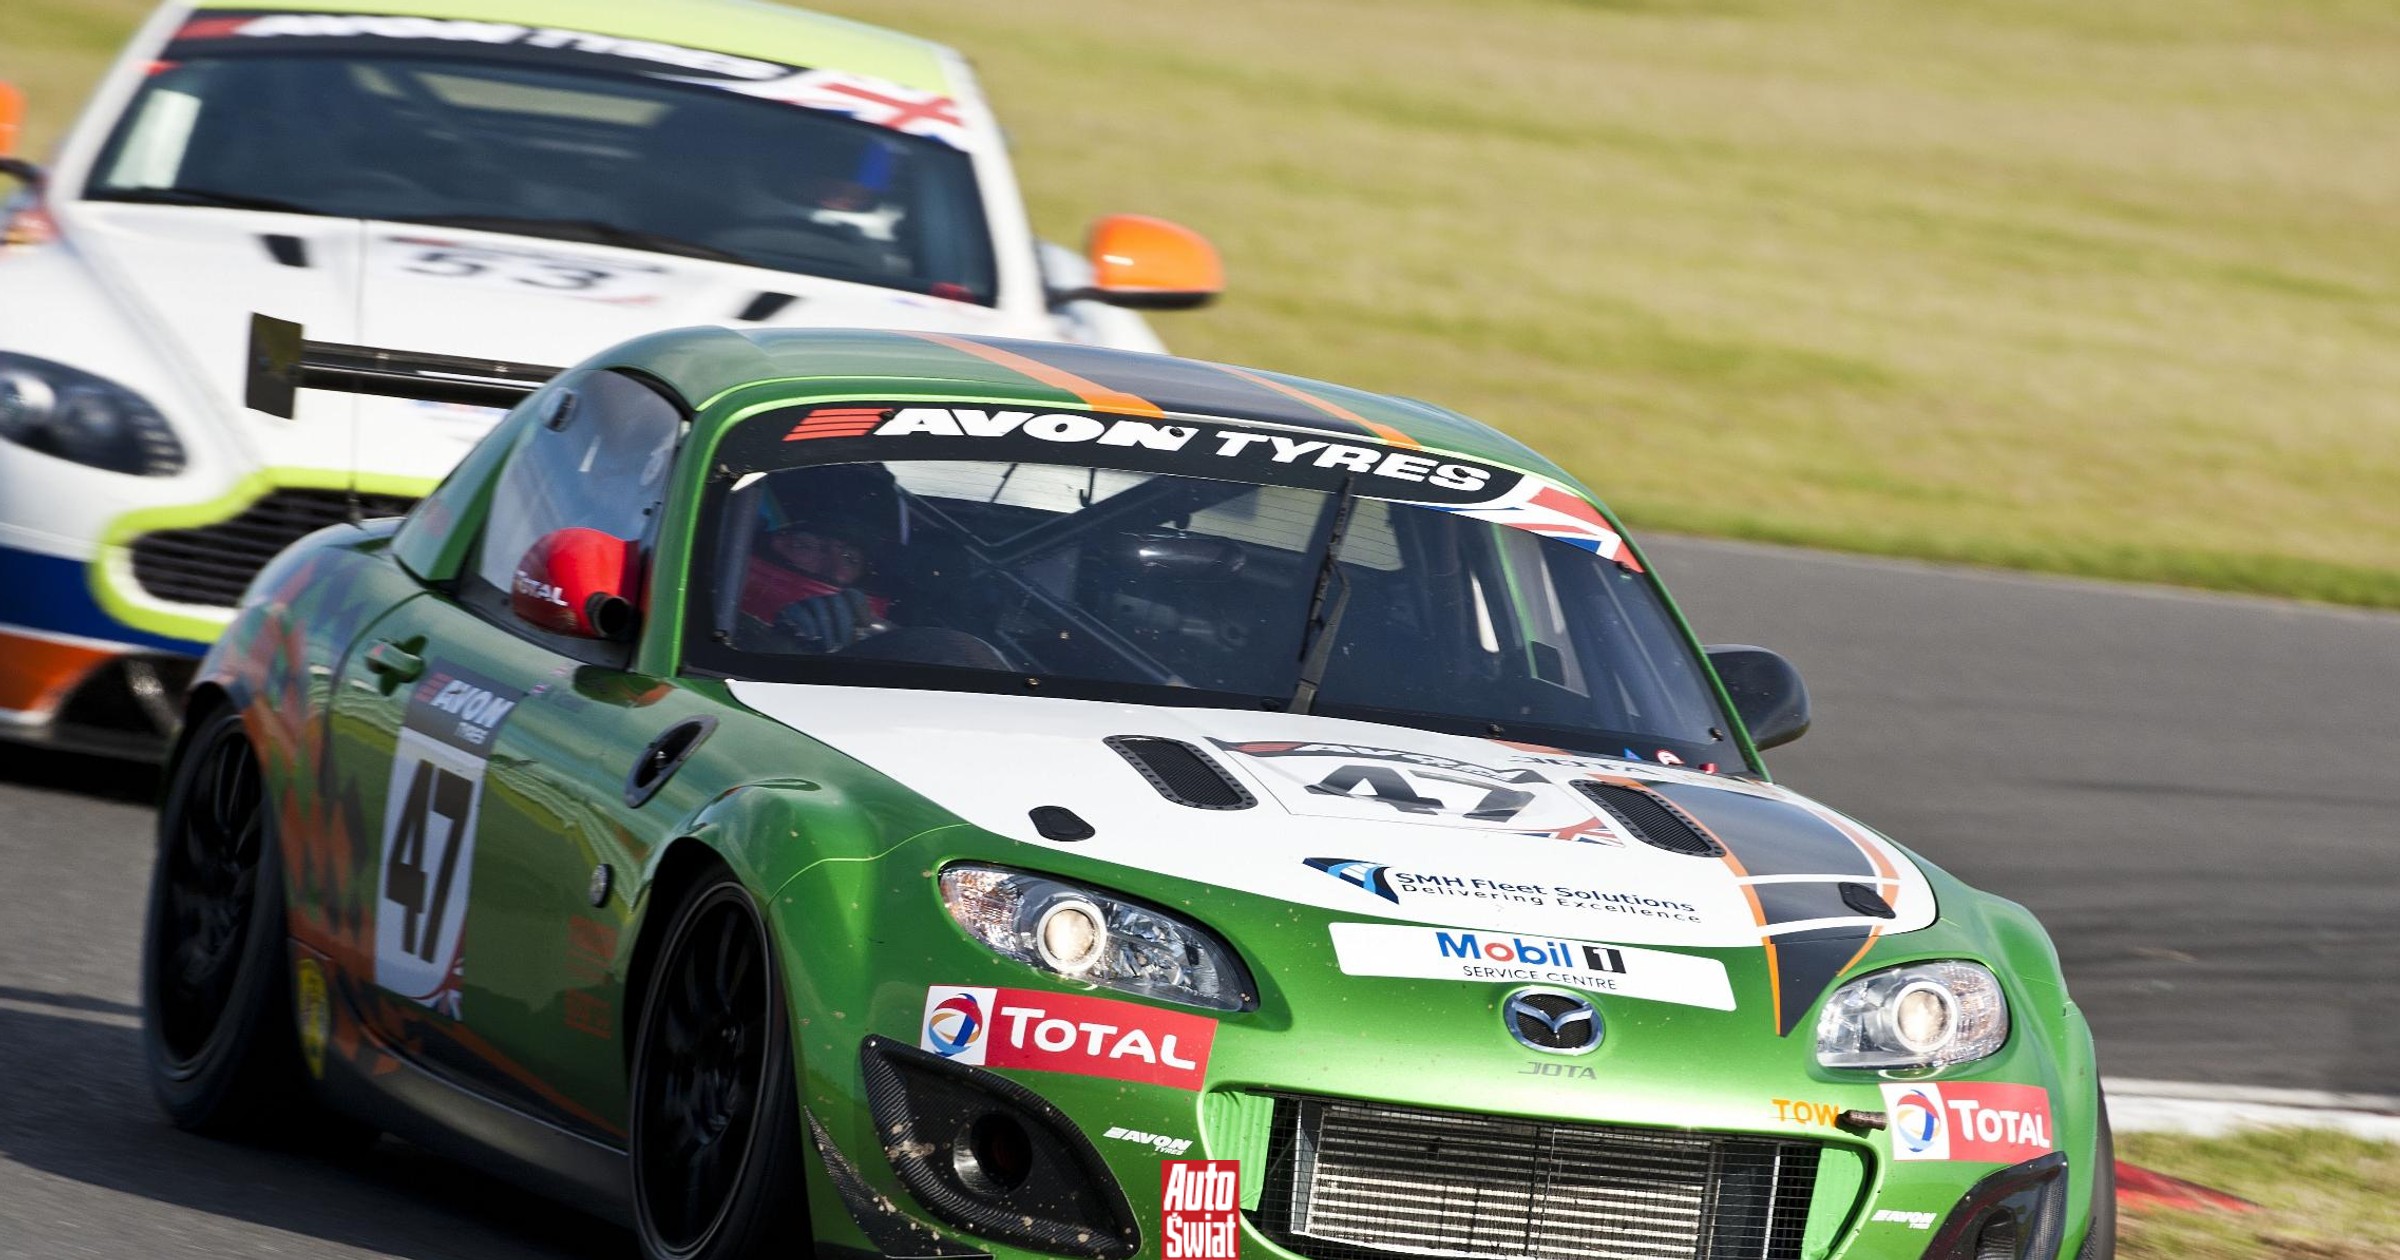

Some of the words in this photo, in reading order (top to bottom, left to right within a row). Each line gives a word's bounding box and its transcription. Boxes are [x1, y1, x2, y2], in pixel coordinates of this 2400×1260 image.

[873, 408, 1199, 451] AVON
[1215, 430, 1491, 492] TYRES
[429, 679, 516, 728] AVON
[1304, 765, 1536, 822] 47
[386, 759, 474, 965] 47
[1395, 872, 1465, 888] SMH
[1471, 878, 1547, 895] Fleet
[1554, 886, 1697, 912] Solutions
[1401, 884, 1544, 906] Delivering
[1556, 898, 1702, 924] Excellence
[1435, 931, 1573, 968] Mobil
[1463, 965, 1542, 981] SERVICE
[1546, 972, 1617, 990] CENTRE
[1000, 1006, 1196, 1070] TOTAL
[1517, 1061, 1598, 1080] JOTA
[1772, 1099, 1840, 1128] TOW
[1947, 1099, 2050, 1149] TOTAL
[1121, 1131, 1194, 1151] AVON
